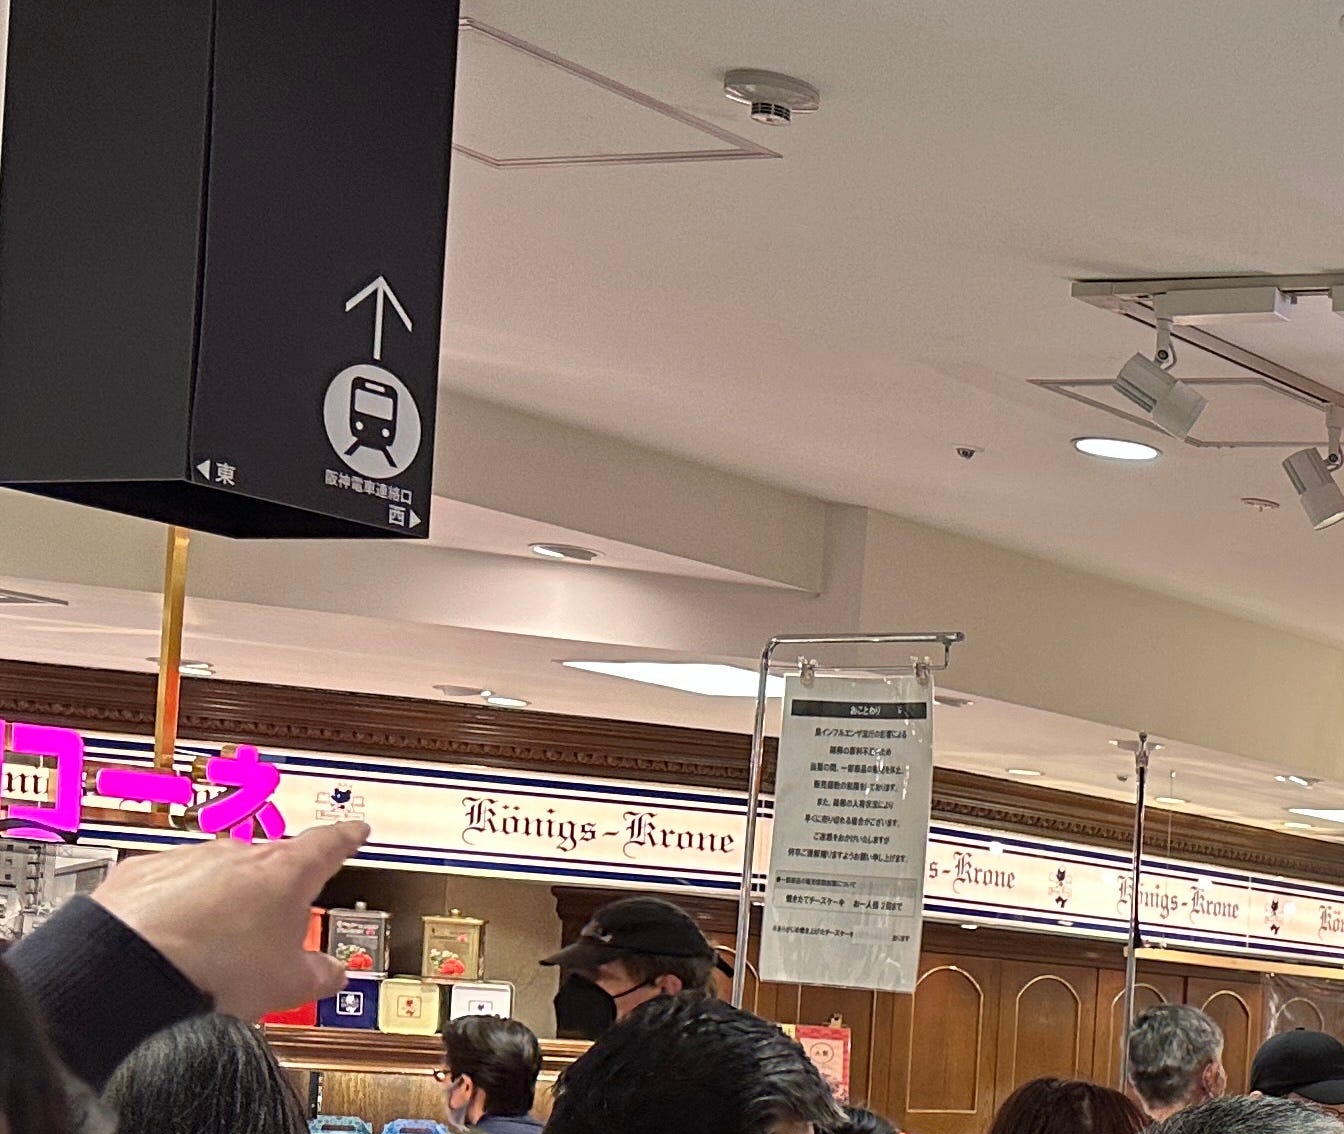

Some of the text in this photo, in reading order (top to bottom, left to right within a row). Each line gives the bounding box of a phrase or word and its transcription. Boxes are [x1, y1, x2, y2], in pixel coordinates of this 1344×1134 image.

[215, 462, 236, 486] 東
[325, 469, 412, 504] 阪神電車連絡口
[388, 504, 405, 526] 西
[850, 705, 881, 716] おことわり
[461, 796, 735, 859] Königs-Krone
